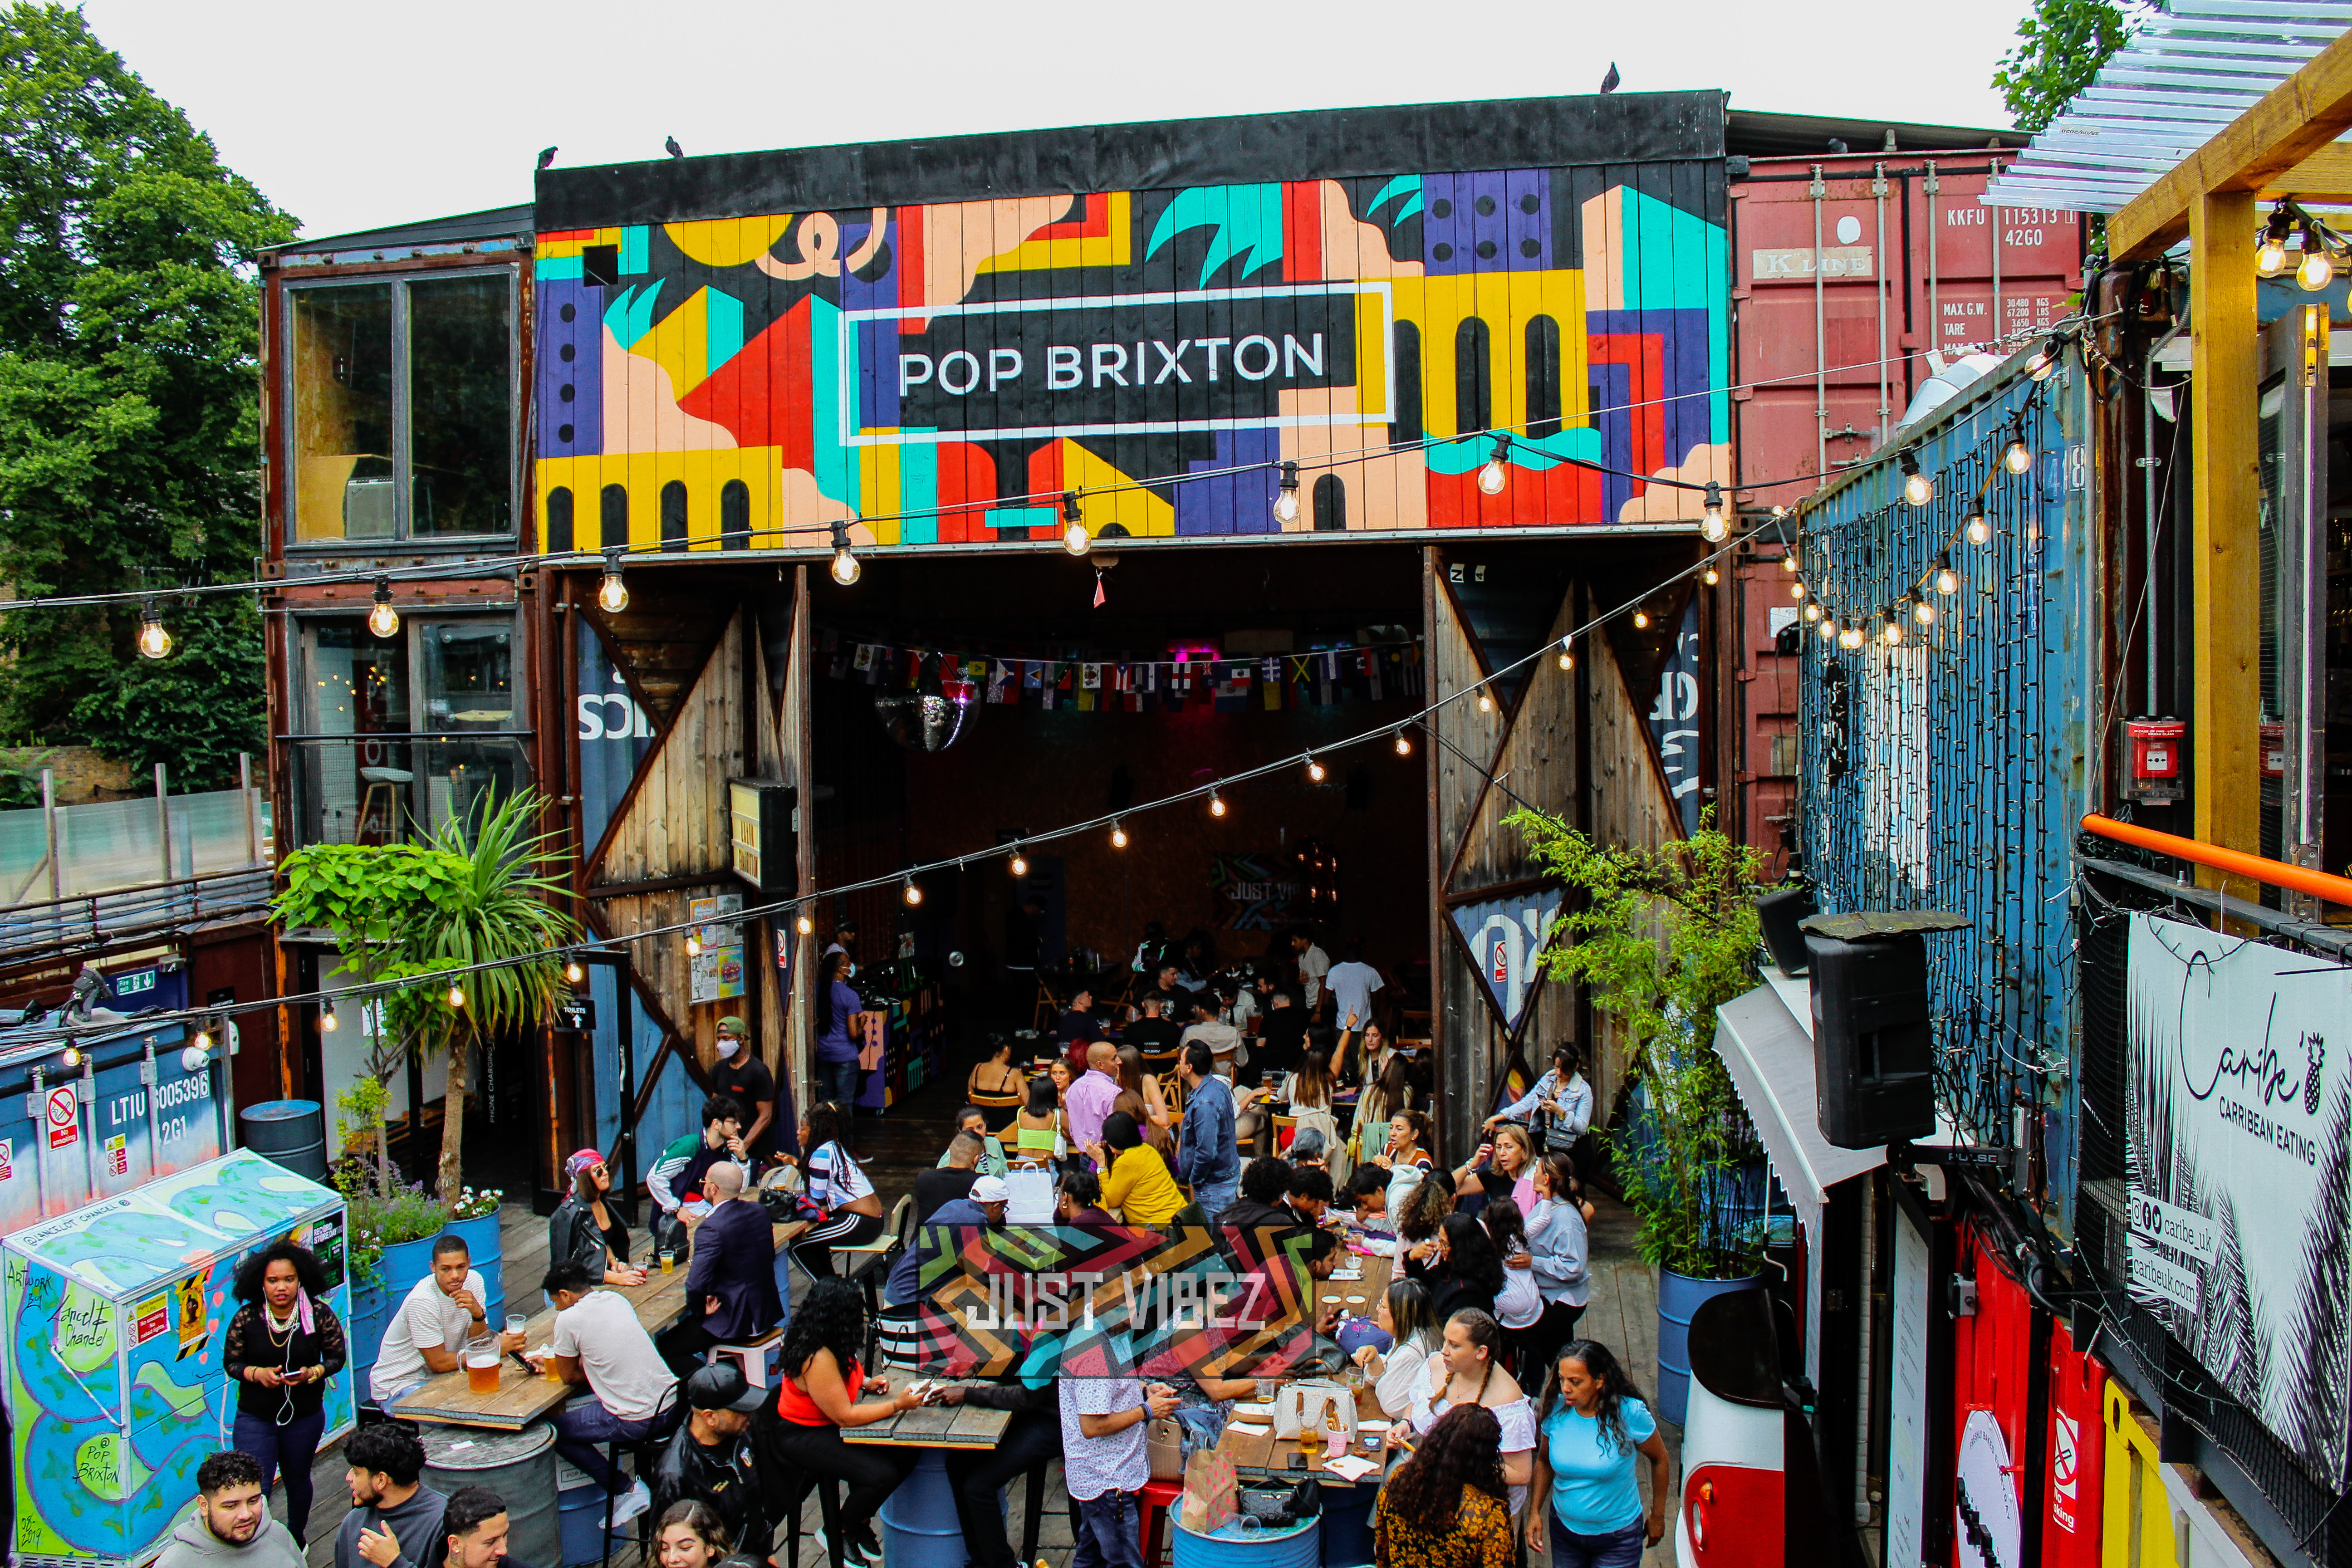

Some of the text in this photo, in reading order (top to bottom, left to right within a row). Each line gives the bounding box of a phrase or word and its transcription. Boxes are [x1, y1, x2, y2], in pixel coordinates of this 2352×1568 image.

[1947, 209, 1985, 226] KKFU
[2004, 208, 2058, 225] 115313
[1802, 257, 1866, 272] LINE
[2036, 297, 2049, 306] KGS
[2036, 307, 2049, 316] LBS
[1944, 323, 1965, 336] TARE
[2011, 317, 2050, 327] 3.650 KGS
[899, 332, 1323, 397] POP BRIXTON
[1231, 882, 1272, 901] JUST
[111, 1069, 210, 1126] LTIU 005396
[158, 1115, 186, 1146] 2G1
[2219, 1095, 2315, 1167] CARRIBEAN EATING
[52, 1134, 77, 1146] smoking
[314, 1222, 333, 1236] RECORD
[2164, 1218, 2212, 1254] caribe_uk
[314, 1231, 329, 1245] STORE
[2133, 1258, 2195, 1306] caribeuk.com
[100, 1437, 110, 1449] @
[2053, 1500, 2074, 1528] oking
